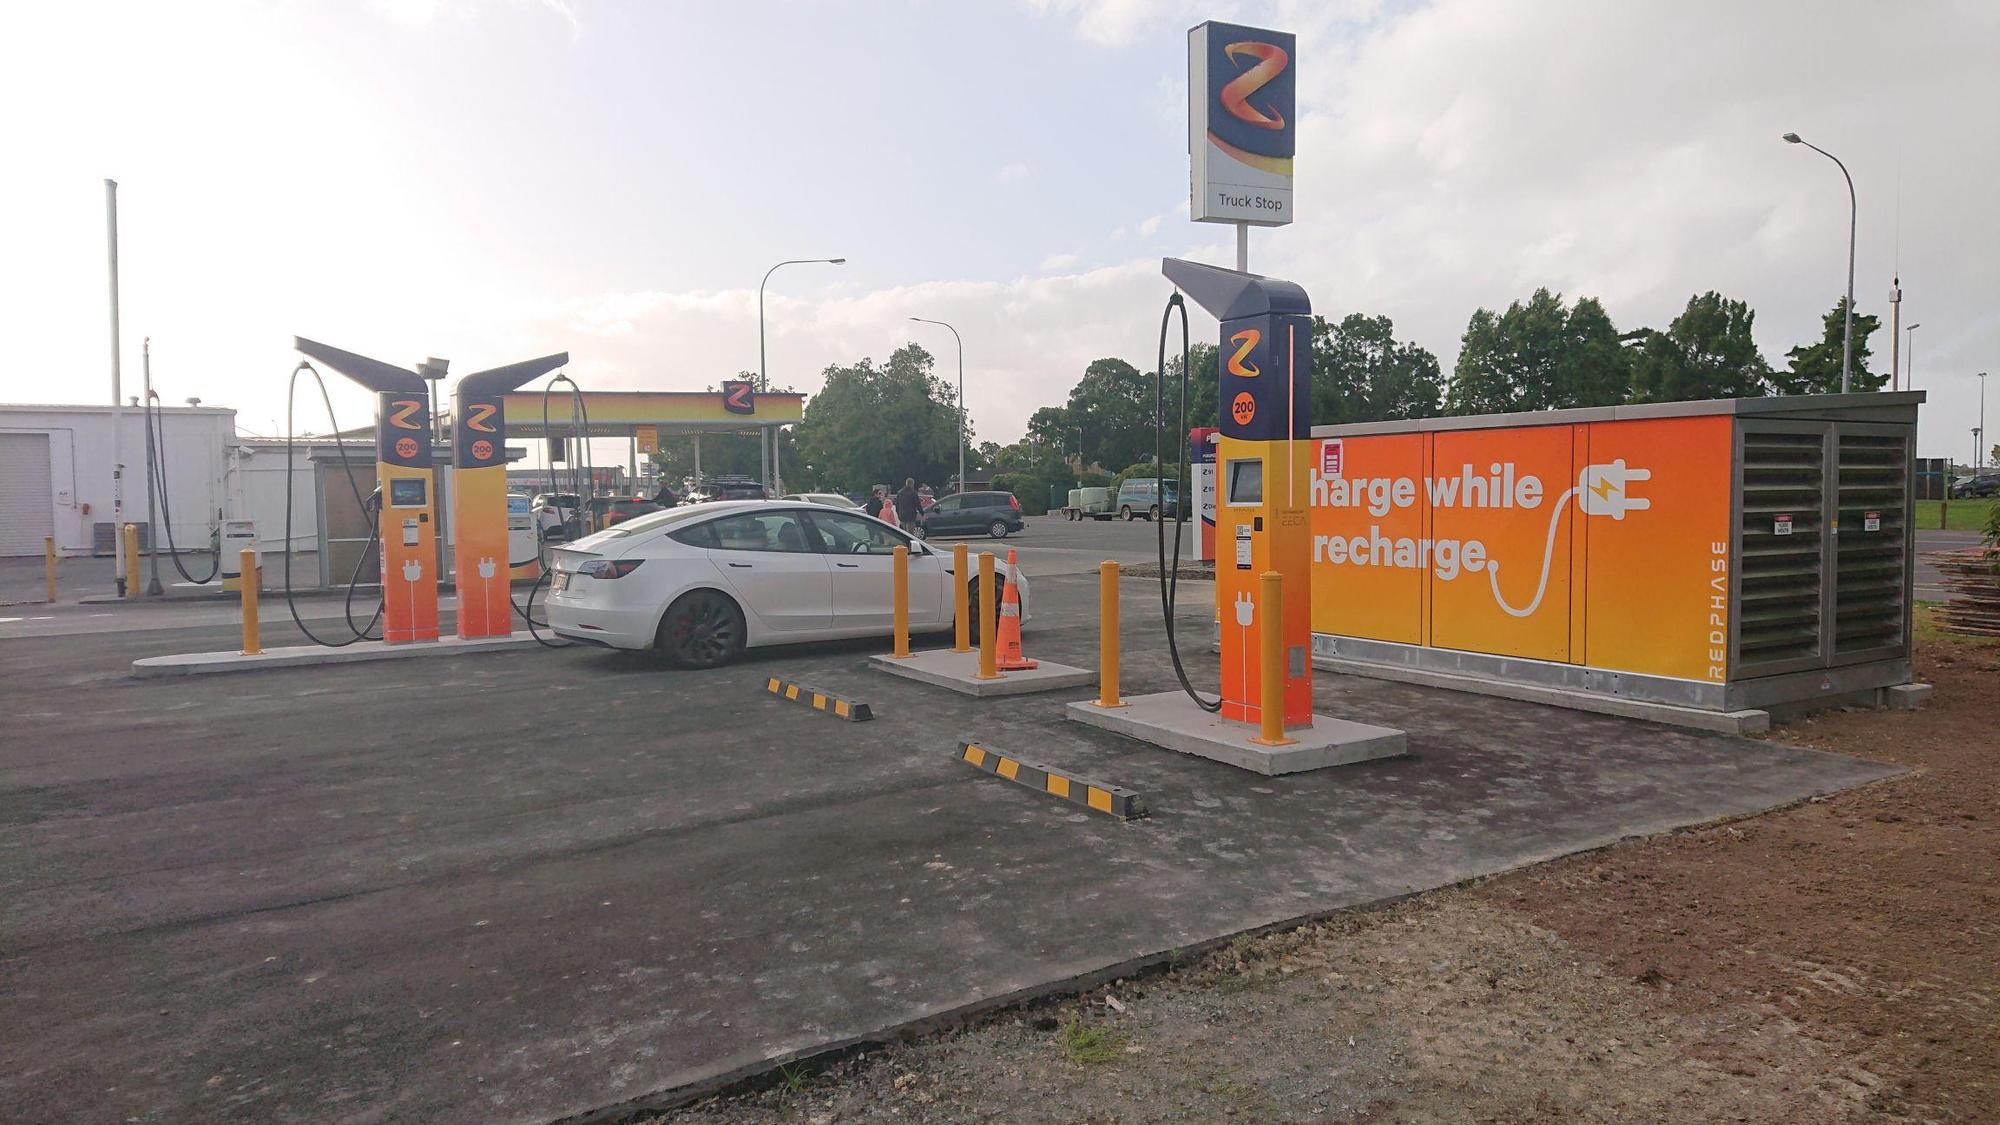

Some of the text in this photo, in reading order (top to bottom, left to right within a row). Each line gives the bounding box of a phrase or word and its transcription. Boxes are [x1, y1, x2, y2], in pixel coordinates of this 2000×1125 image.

[1218, 193, 1283, 212] Truck Stop
[1234, 401, 1254, 414] 200
[398, 442, 416, 451] 200
[473, 445, 491, 453] 200
[1310, 463, 1544, 517] harge while
[1313, 525, 1487, 581] recharge
[1709, 541, 1727, 679] REDPHASE
